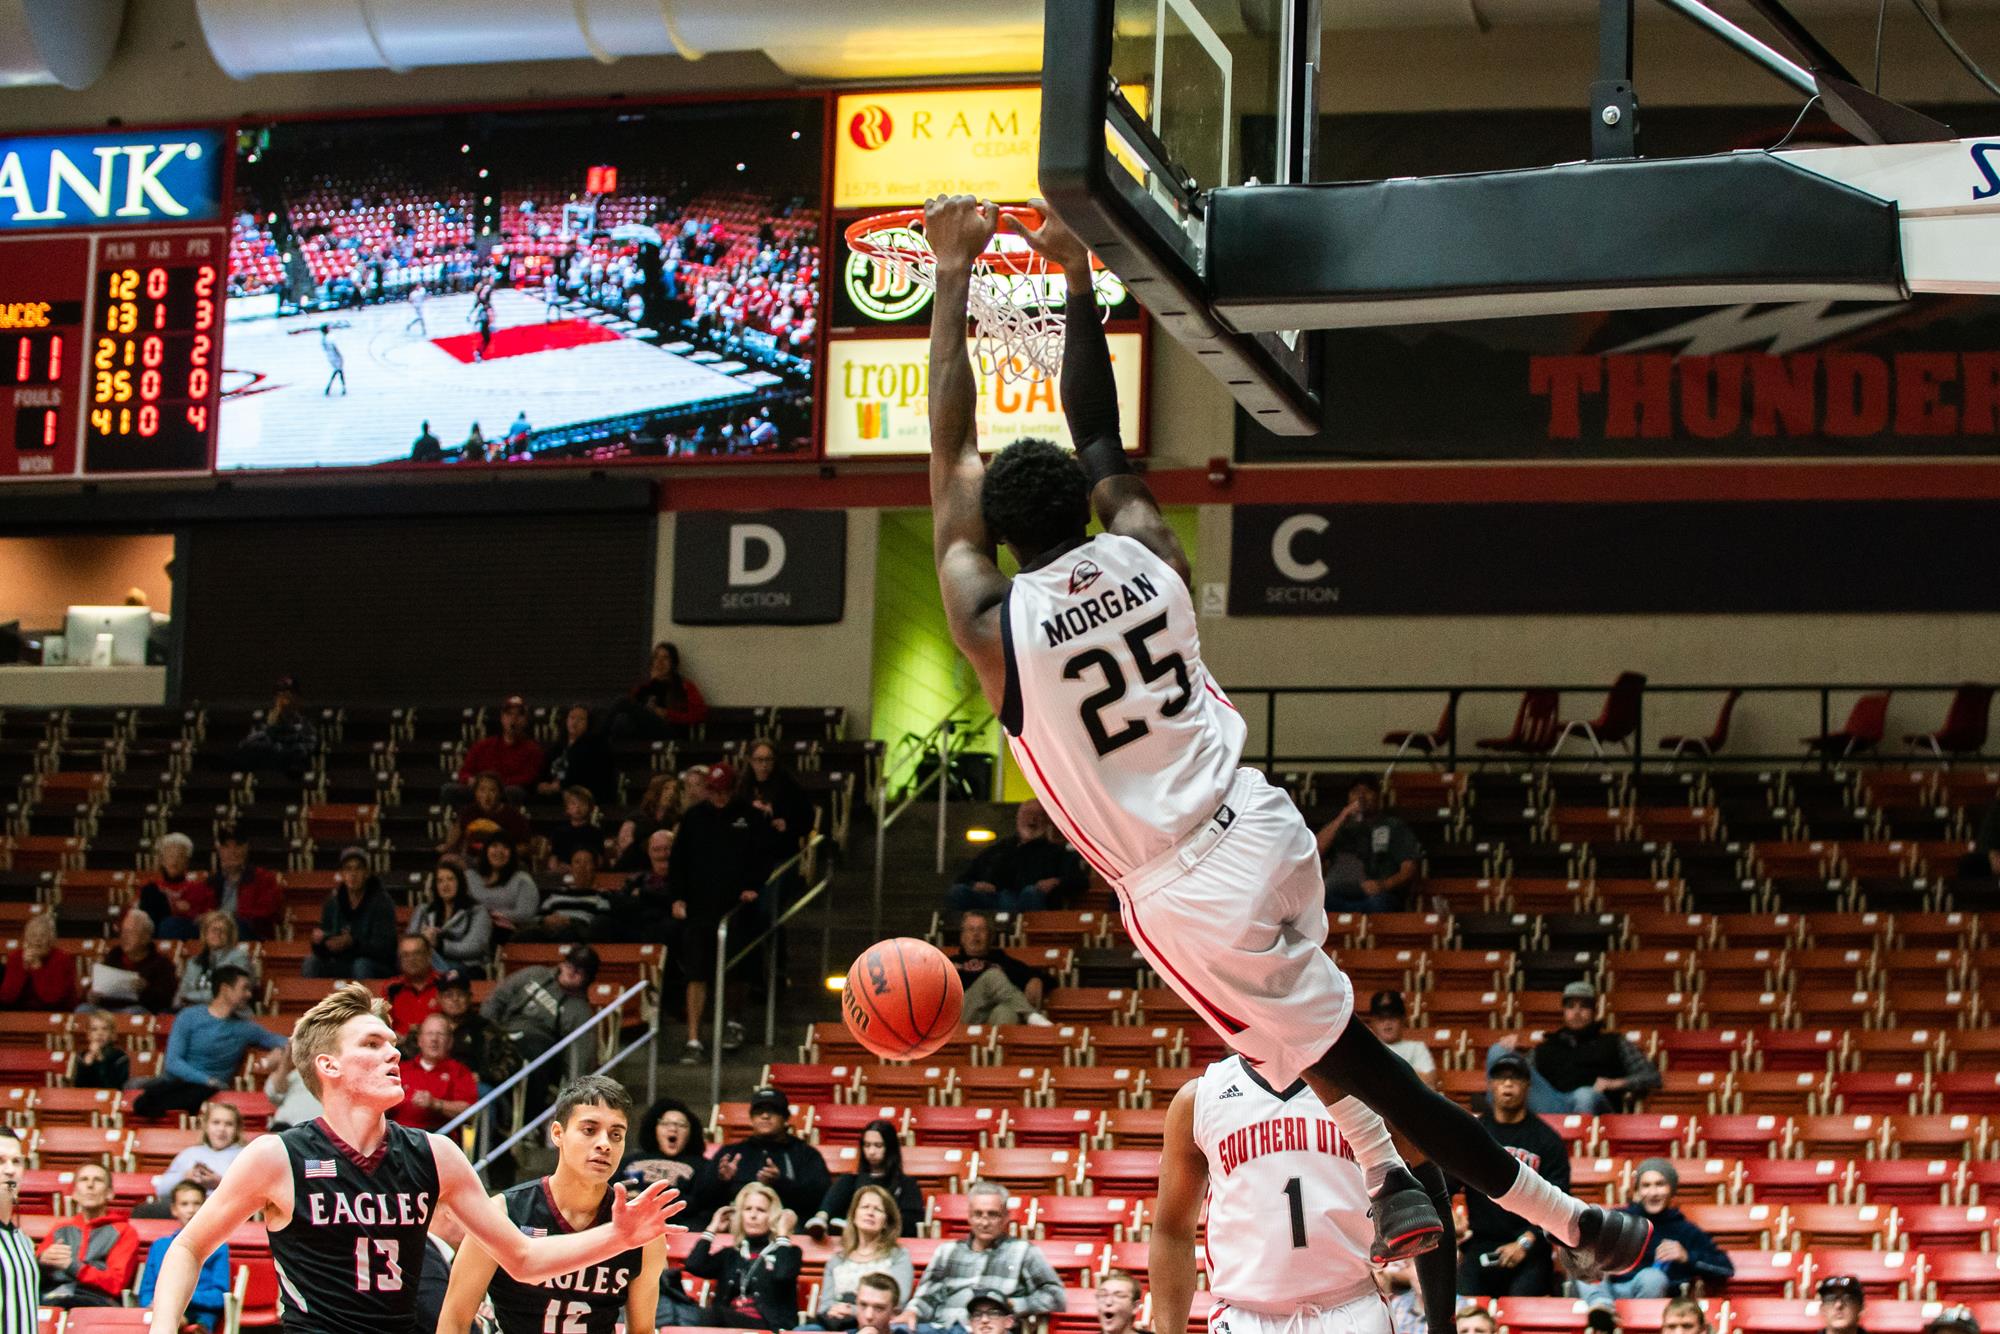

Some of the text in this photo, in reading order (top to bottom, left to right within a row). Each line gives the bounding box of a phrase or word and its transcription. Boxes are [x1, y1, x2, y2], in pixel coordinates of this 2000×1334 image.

[109, 265, 217, 301] 12 0 2
[107, 298, 214, 334] 13 1 3
[16, 335, 63, 382] 11
[95, 334, 212, 370] 21 0 2
[95, 367, 209, 403] 35 0 0
[43, 409, 57, 446] 1
[91, 404, 207, 438] 41 0 4
[728, 523, 787, 587] D
[1271, 513, 1330, 582] C
[720, 591, 792, 609] SECTION
[1040, 572, 1159, 648] MORGAN
[1265, 586, 1340, 603] SECTION
[1061, 606, 1192, 761] 25
[1218, 1091, 1244, 1100] adidas
[1218, 1116, 1308, 1177] SOUTHERN
[309, 1191, 430, 1226] EAGLES
[1281, 1175, 1309, 1250] 1
[354, 1236, 403, 1292] 13
[543, 1298, 593, 1334] 12
